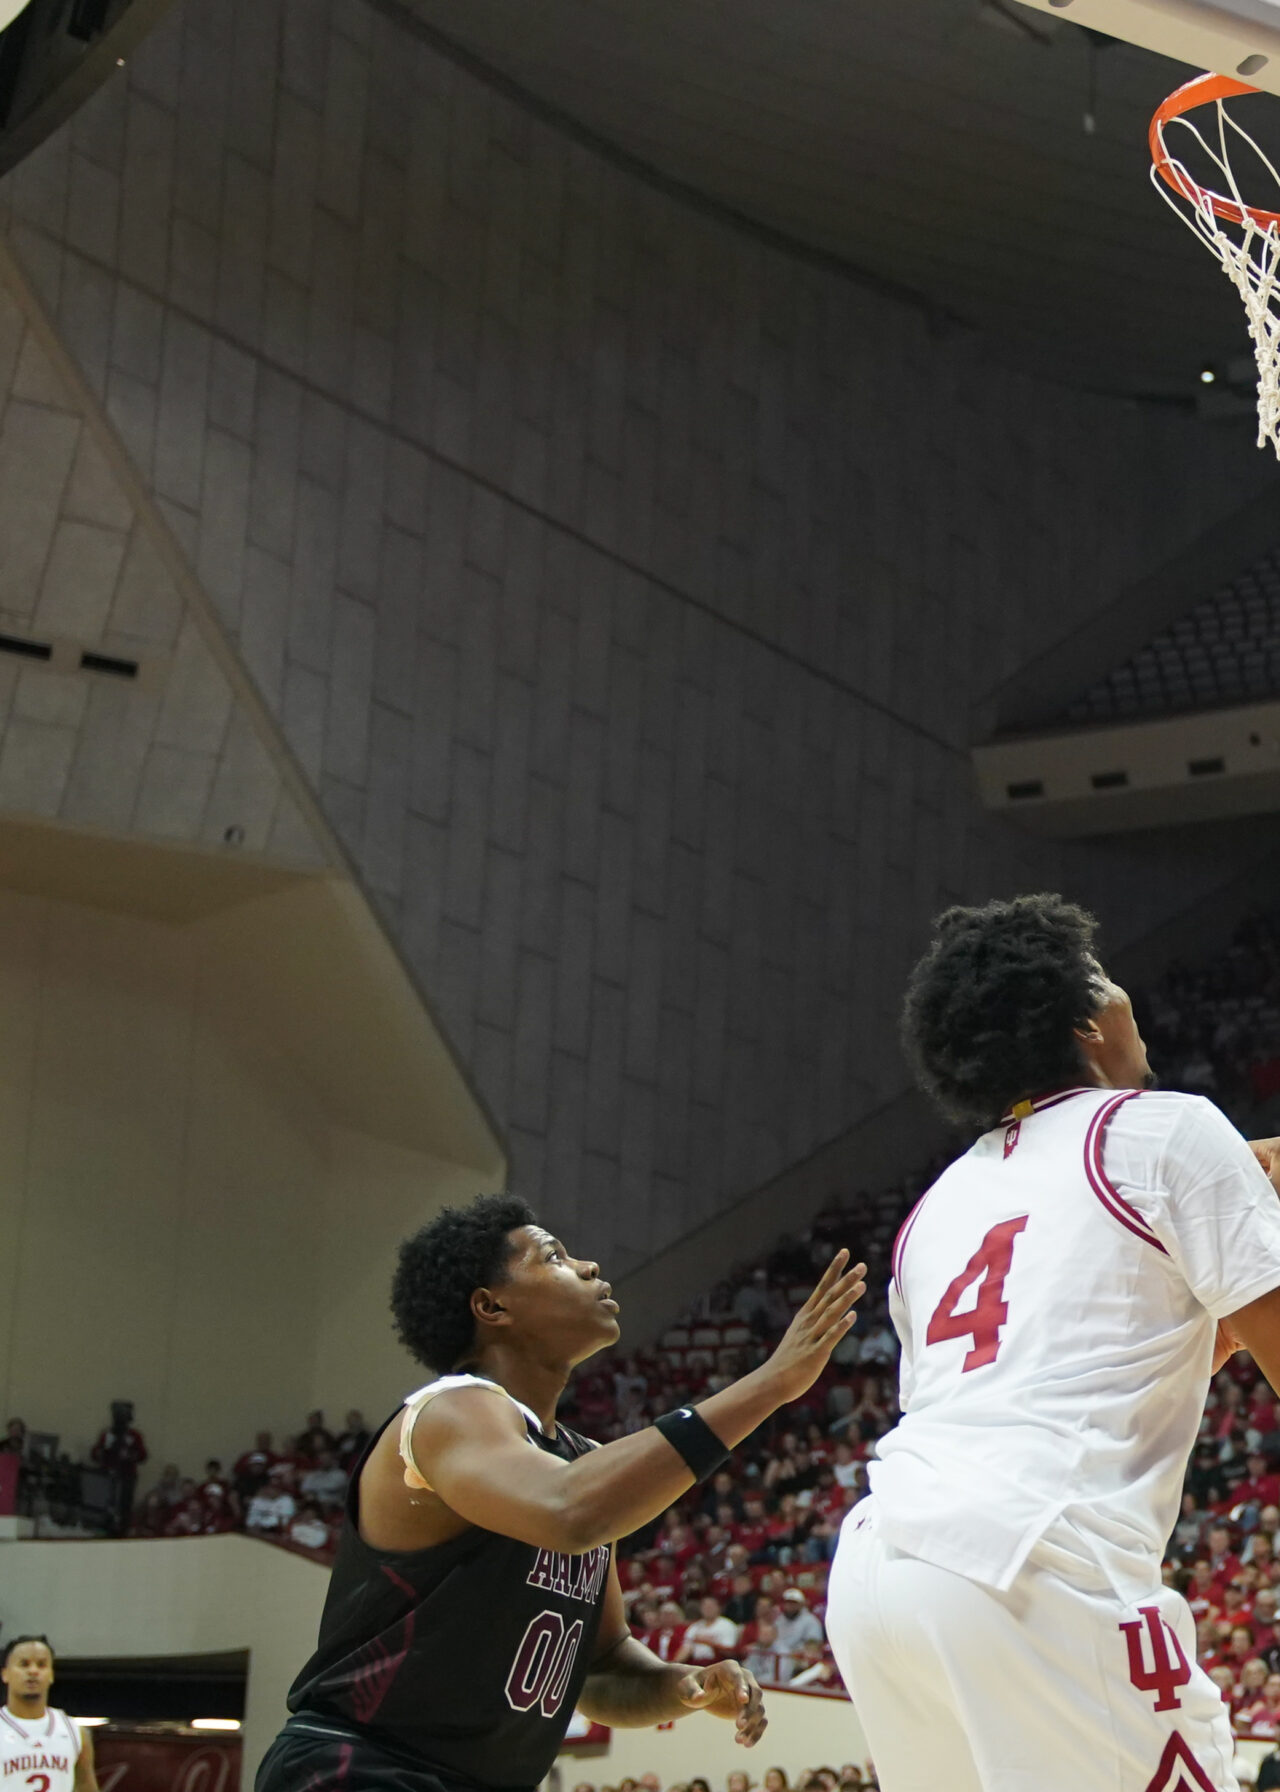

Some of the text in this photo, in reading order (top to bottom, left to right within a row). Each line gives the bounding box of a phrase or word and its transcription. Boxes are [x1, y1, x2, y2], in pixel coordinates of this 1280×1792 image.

[926, 1214, 1029, 1373] 4
[504, 1609, 584, 1718] 00
[1118, 1606, 1192, 1712] IU
[4, 1754, 68, 1776] INDIANA
